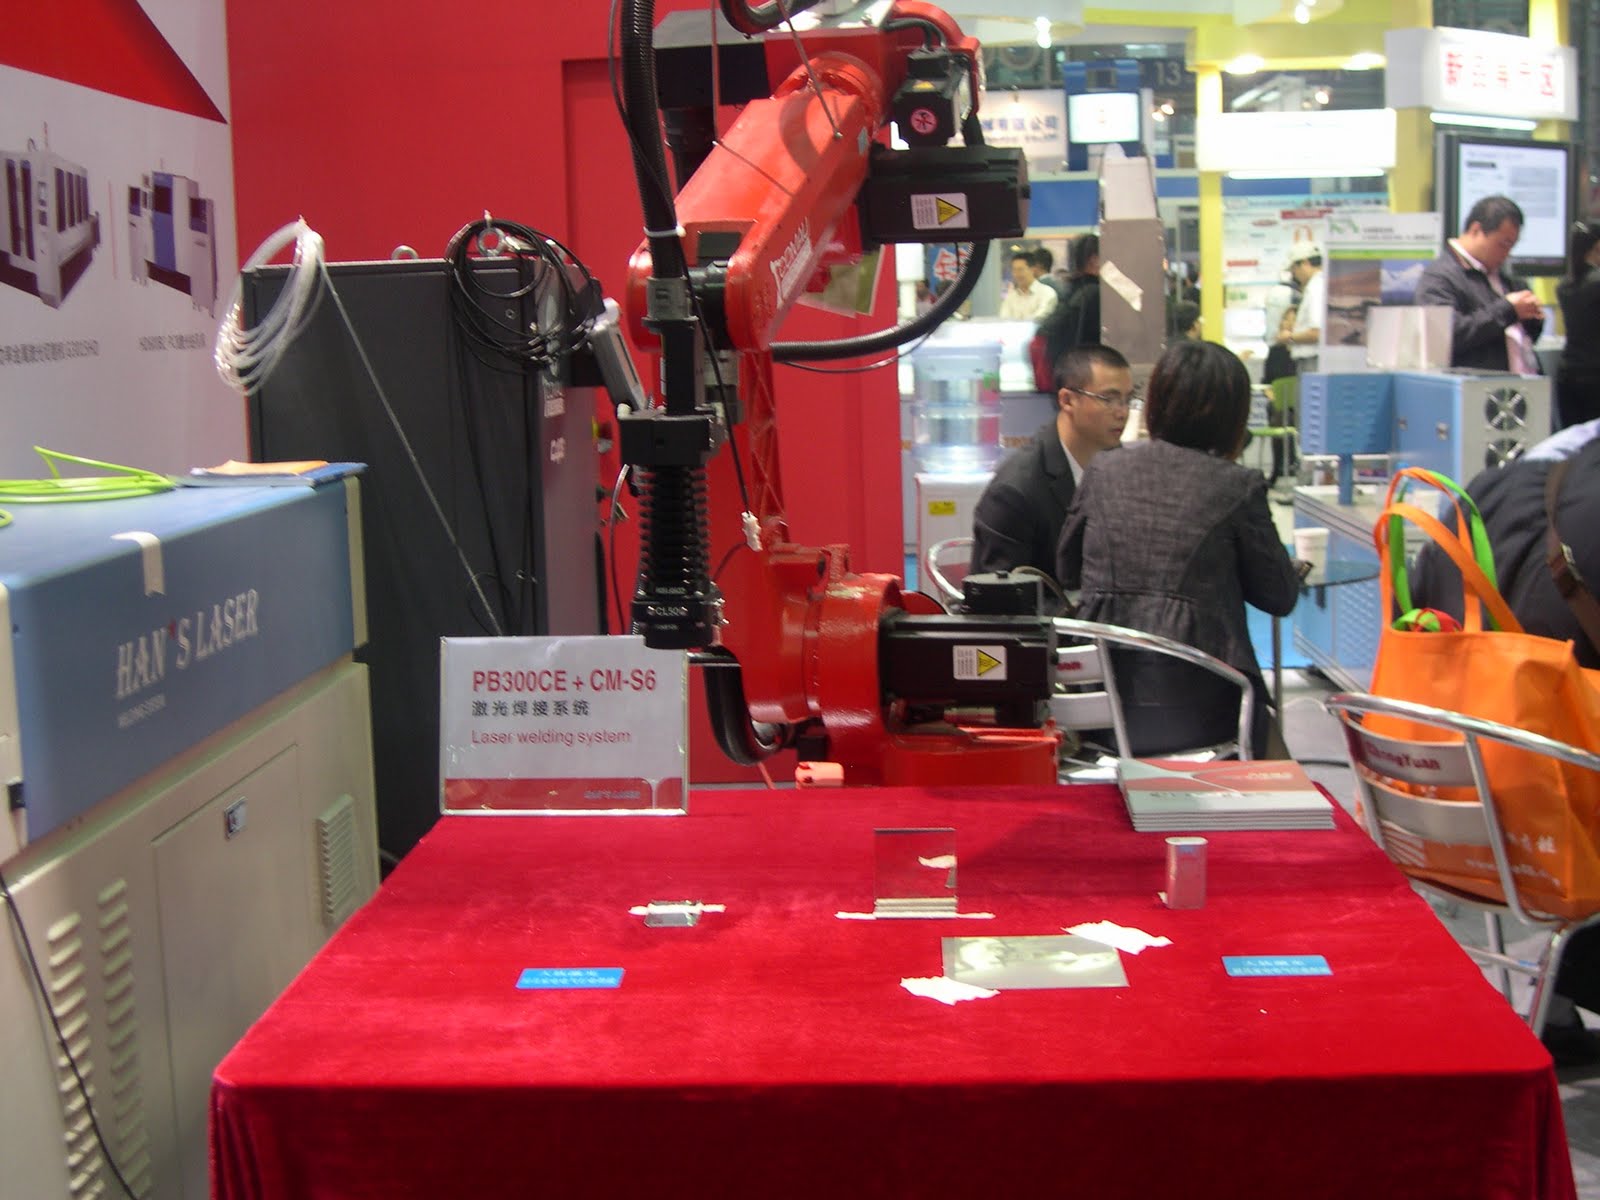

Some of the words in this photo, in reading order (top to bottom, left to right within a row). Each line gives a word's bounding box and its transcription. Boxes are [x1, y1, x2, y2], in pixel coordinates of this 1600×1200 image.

[116, 617, 191, 699] HAN'S
[195, 588, 259, 661] LASER
[472, 670, 567, 692] PB300CE
[572, 676, 584, 689] +
[589, 669, 657, 692] CM-S6
[471, 700, 589, 717] 激光焊接系统
[472, 730, 512, 744] Laser
[516, 730, 573, 747] welding
[577, 732, 631, 747] system
